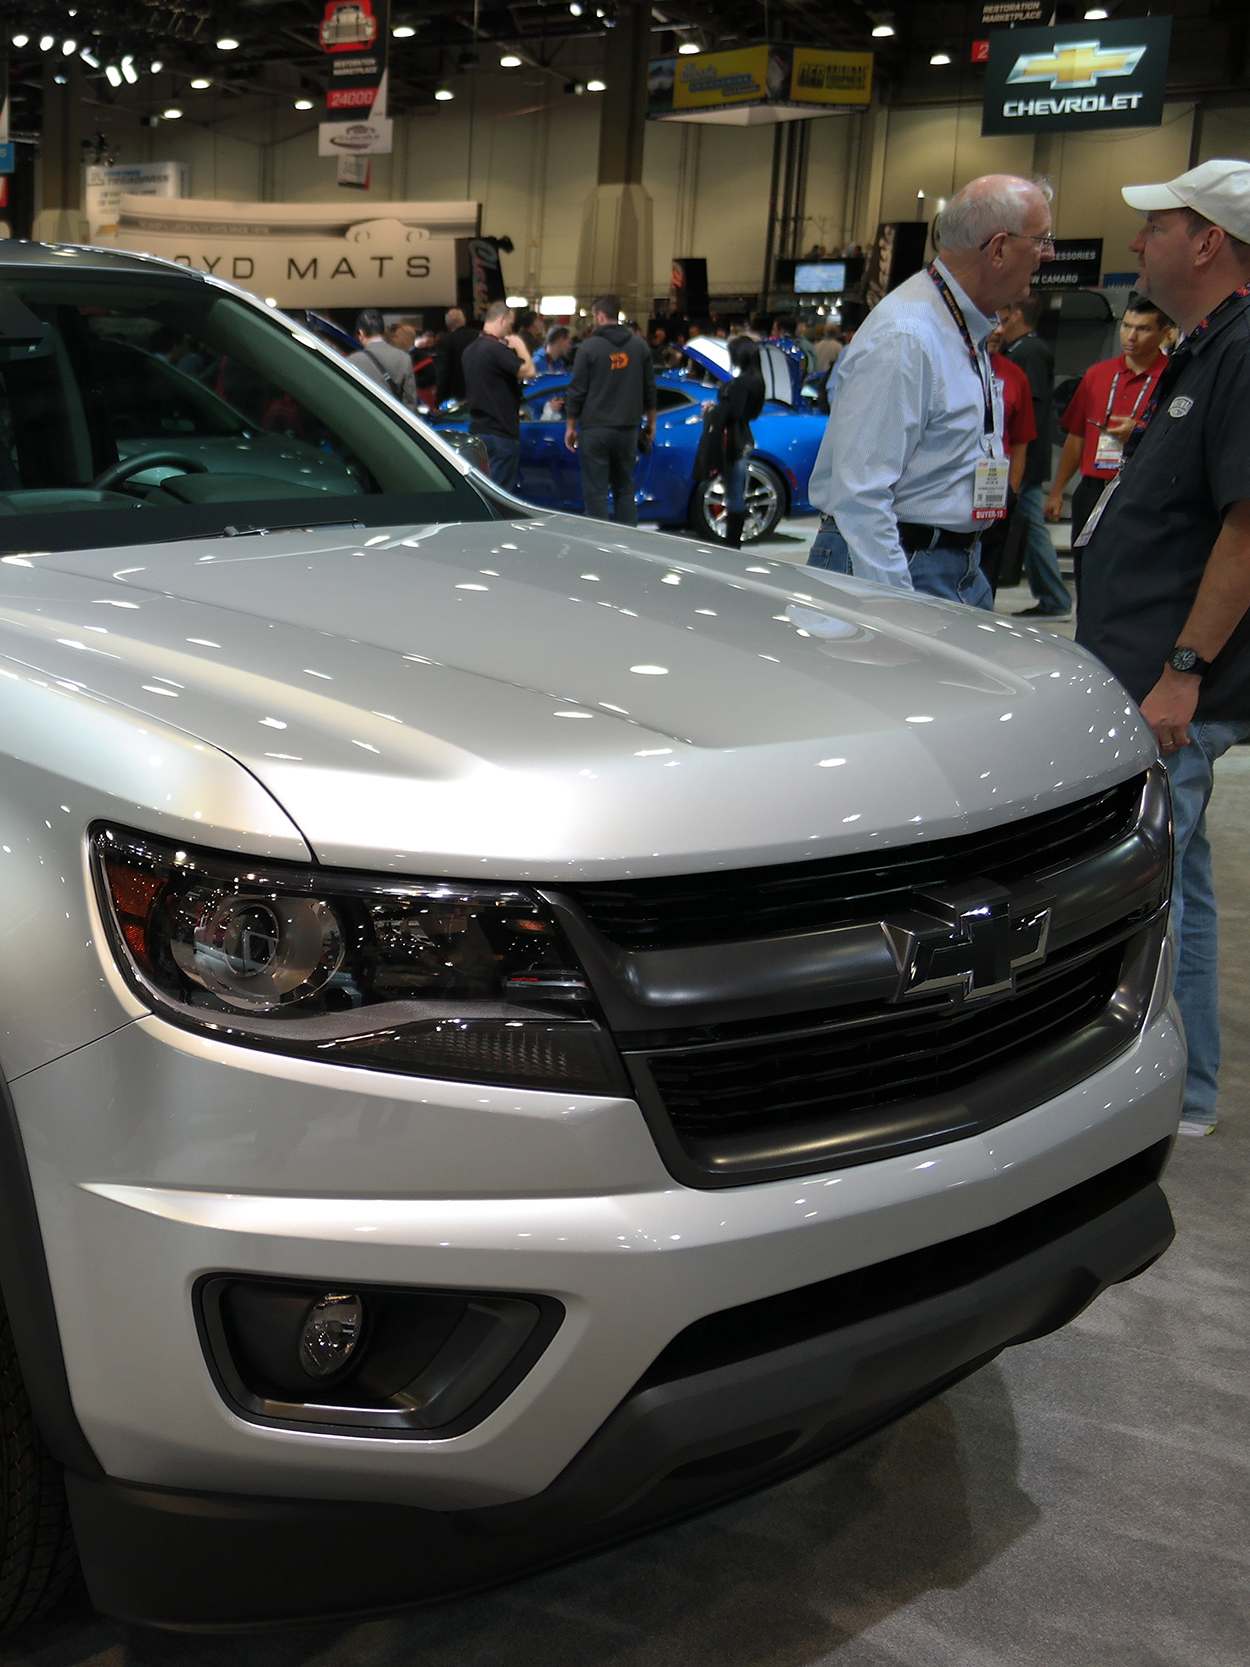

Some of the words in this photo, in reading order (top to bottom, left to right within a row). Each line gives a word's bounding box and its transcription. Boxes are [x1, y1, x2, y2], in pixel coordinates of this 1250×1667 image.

[983, 2, 1040, 14] RESTORATION
[982, 11, 1041, 23] MARKETPLACE
[978, 44, 989, 59] 2
[1002, 93, 1143, 118] CHEVROLET
[1053, 250, 1096, 261] ESSORIES
[173, 255, 255, 279] OYD
[286, 255, 432, 280] MATS
[1041, 273, 1079, 284] CAMARO
